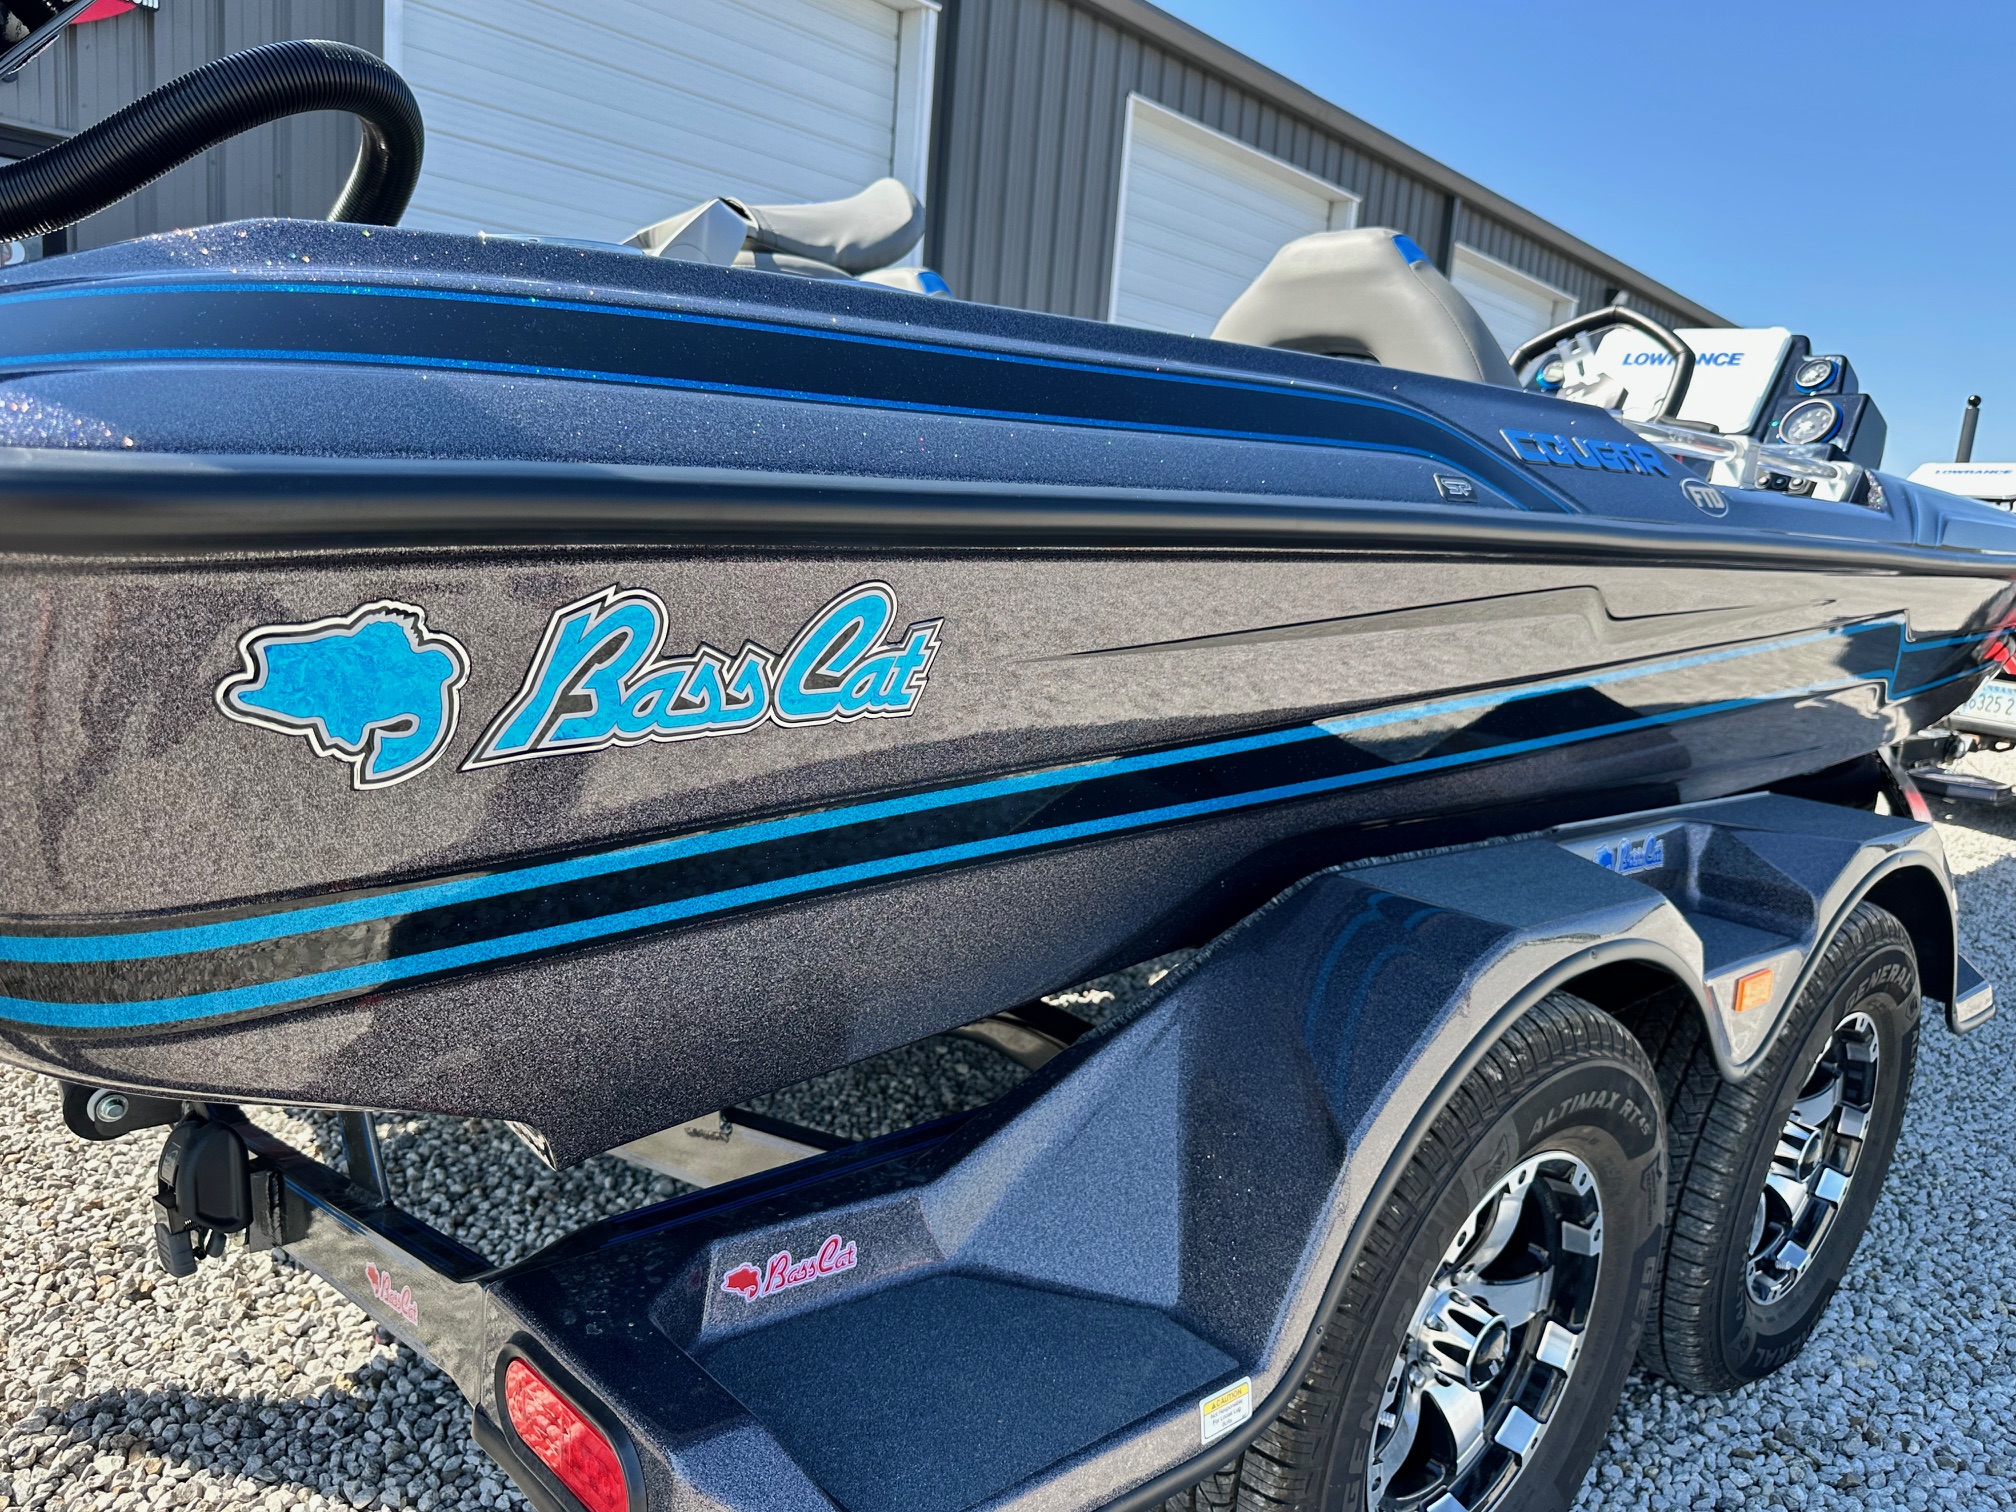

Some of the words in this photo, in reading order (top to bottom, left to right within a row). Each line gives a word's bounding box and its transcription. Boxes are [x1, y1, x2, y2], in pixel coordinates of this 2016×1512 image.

[1622, 352, 1745, 367] LOWNCE
[1500, 428, 1671, 478] COUGAR
[1845, 963, 1913, 1013] GENERAL
[1527, 1090, 1621, 1141] ALTIMAX
[1216, 1389, 1242, 1406] CAUTION
